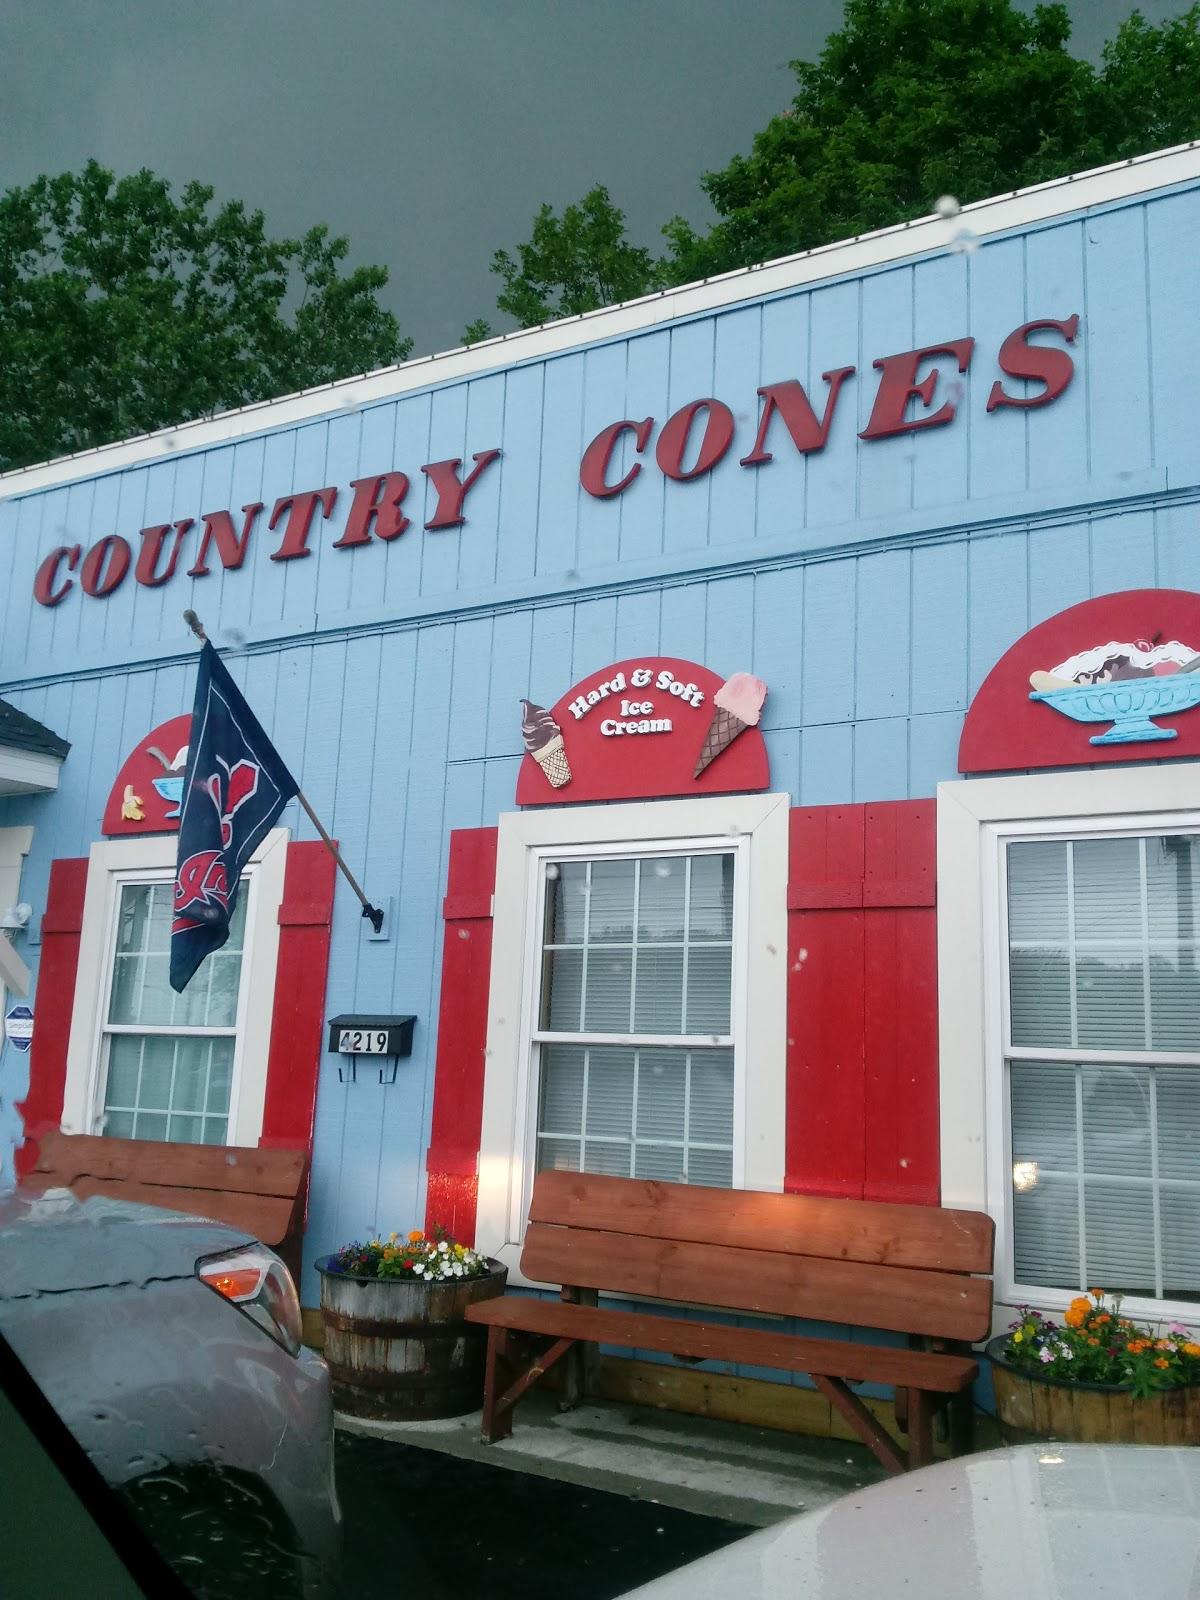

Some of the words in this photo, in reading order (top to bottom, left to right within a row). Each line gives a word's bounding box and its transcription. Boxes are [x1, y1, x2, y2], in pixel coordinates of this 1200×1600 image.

[33, 448, 502, 608] COUNTRY
[579, 313, 1080, 498] CONES
[568, 672, 627, 720] Hard
[630, 668, 654, 688] &
[656, 670, 705, 708] Soft
[620, 699, 654, 717] Ice
[600, 718, 673, 736] Cream
[340, 1031, 387, 1052] 4219
